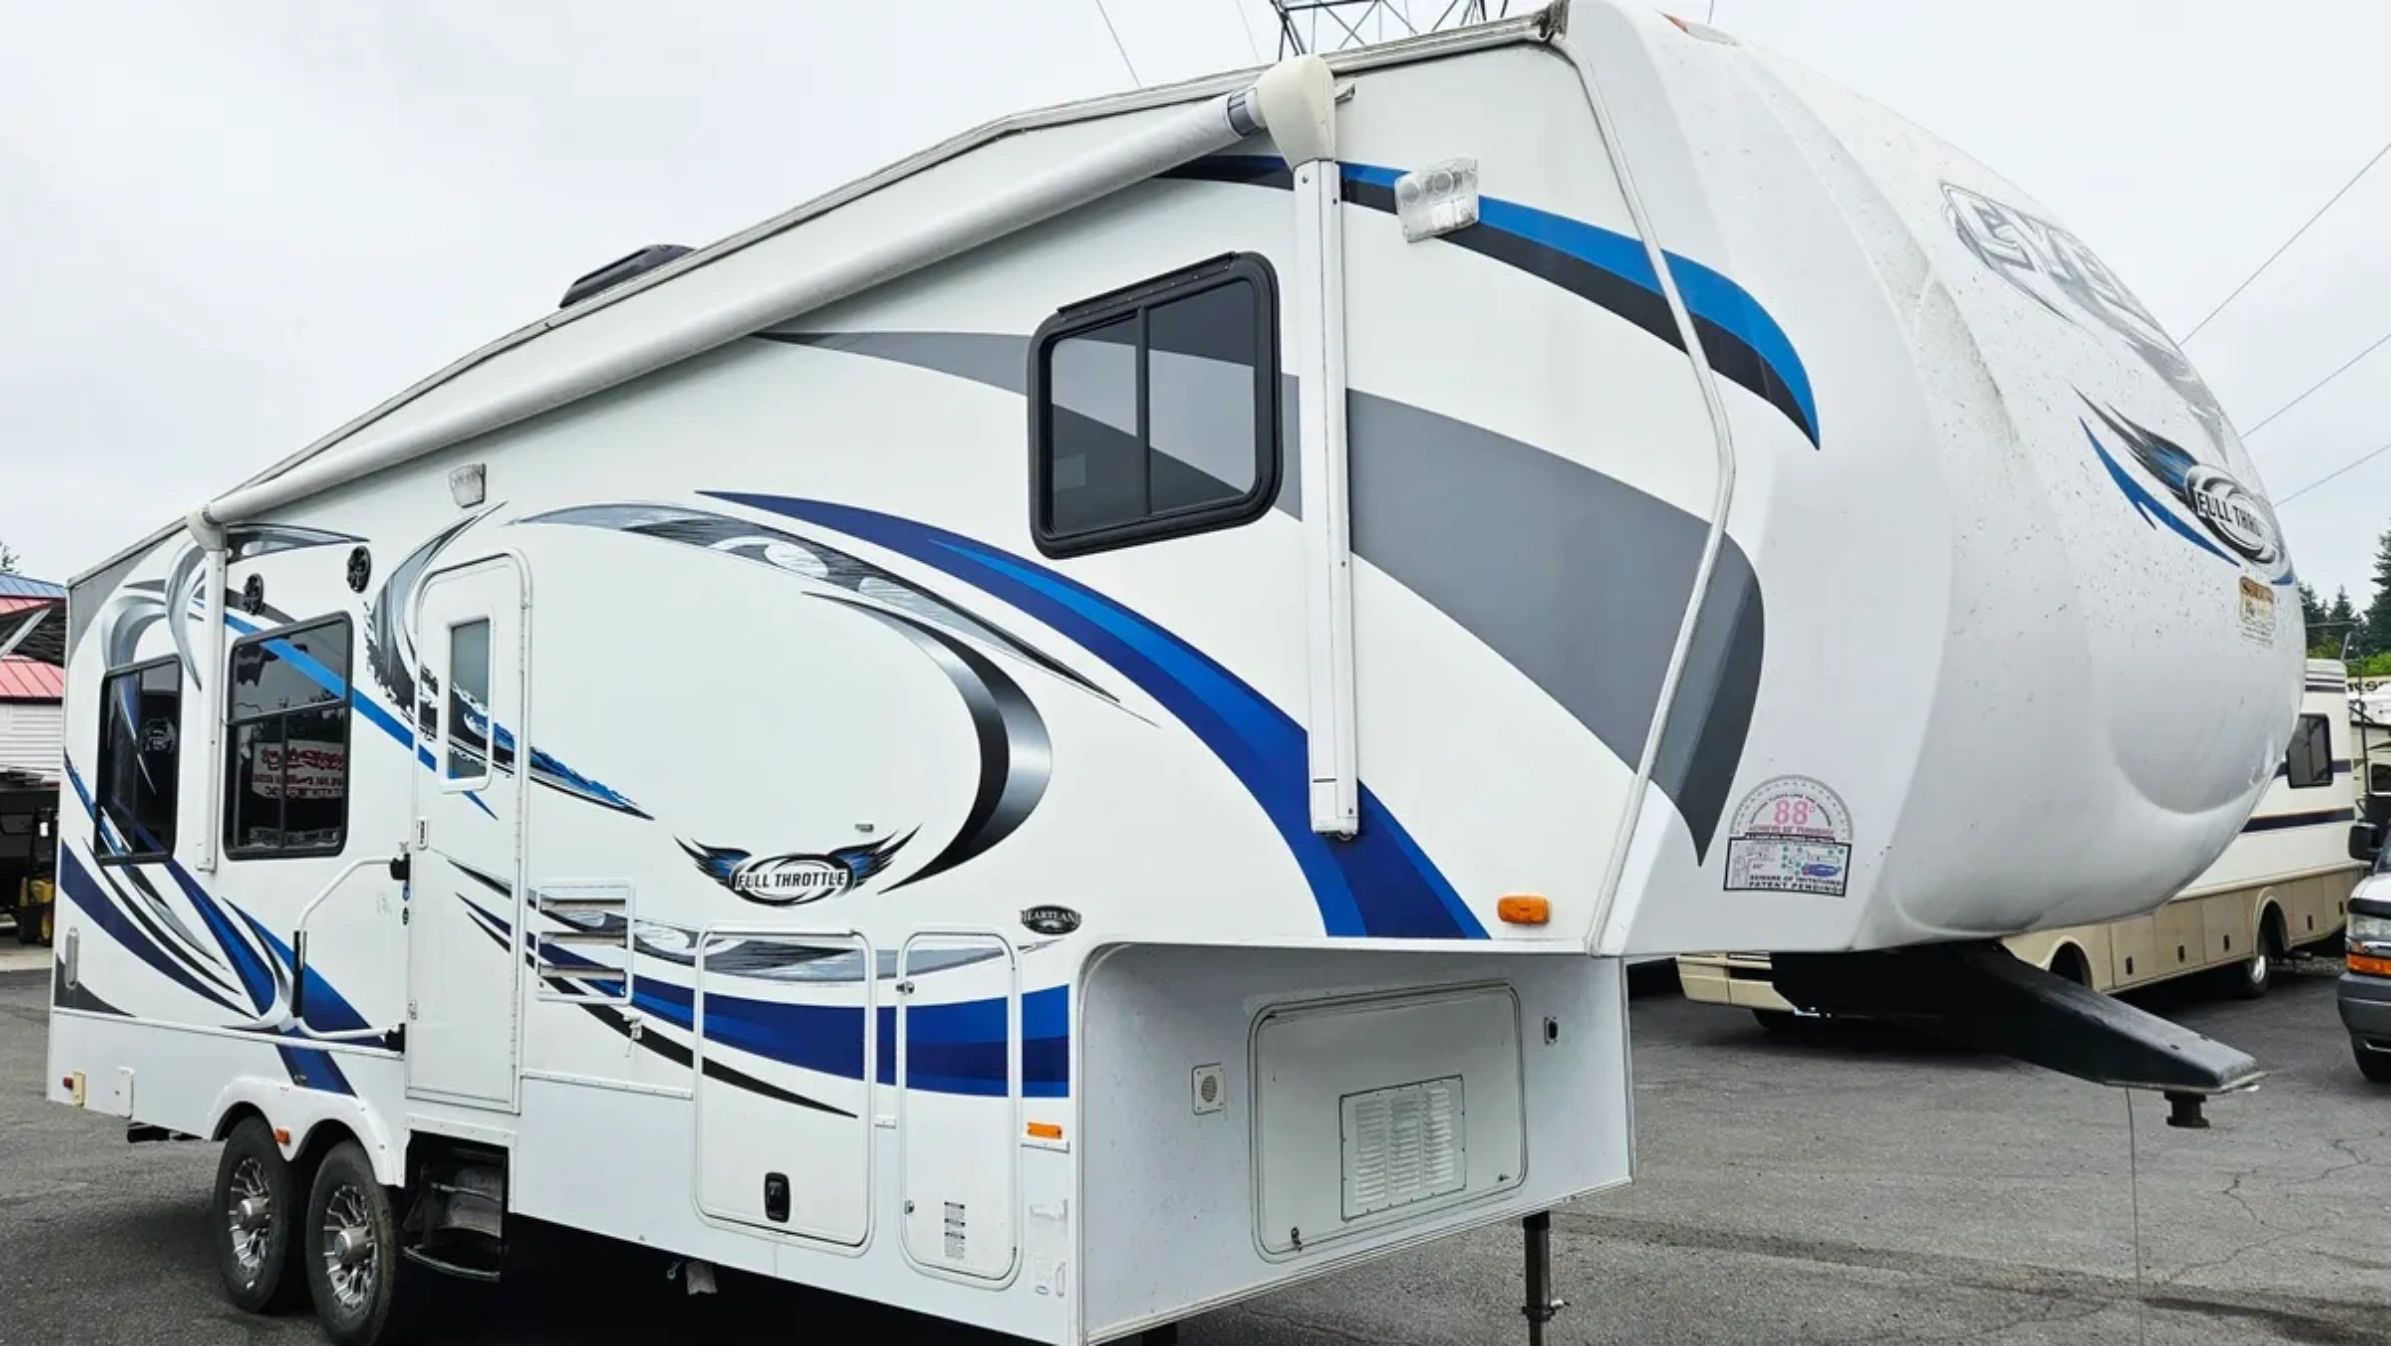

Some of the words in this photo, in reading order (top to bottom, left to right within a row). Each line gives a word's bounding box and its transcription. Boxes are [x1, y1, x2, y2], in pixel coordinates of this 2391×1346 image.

[736, 873, 770, 889] FULL
[774, 871, 846, 888] THROTTLE
[1748, 880, 1787, 888] PATENT
